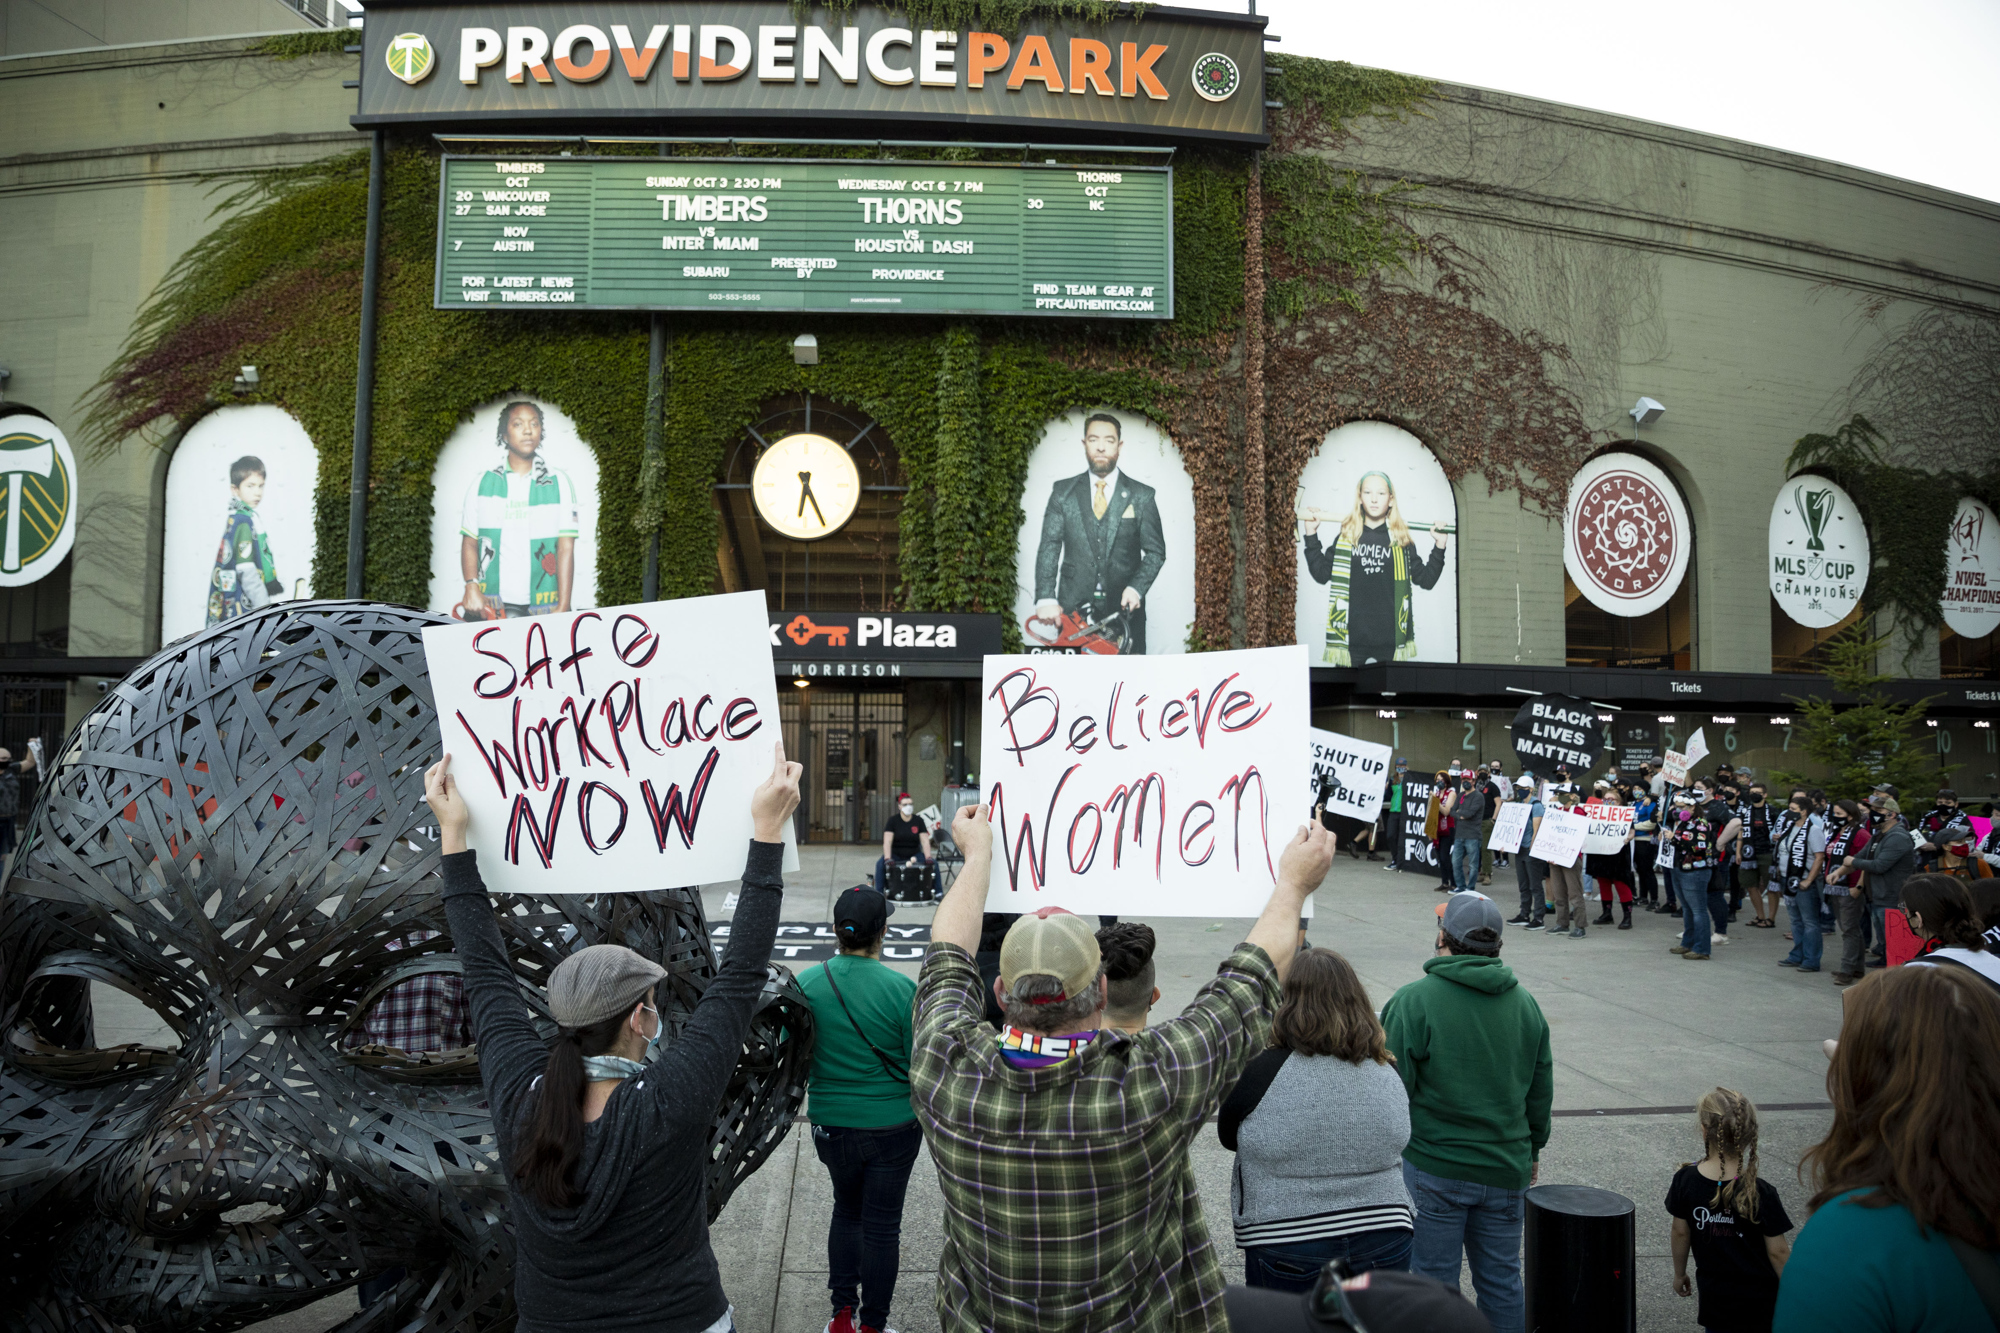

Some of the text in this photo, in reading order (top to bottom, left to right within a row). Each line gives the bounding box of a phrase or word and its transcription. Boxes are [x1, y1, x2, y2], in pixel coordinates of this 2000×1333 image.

[1198, 56, 1234, 74] PORTLAND
[1200, 79, 1234, 94] THORNS
[496, 163, 545, 173] TIMBERS
[506, 177, 529, 188] OCT
[646, 177, 690, 188] SUNDAY
[694, 177, 717, 188] OCT
[719, 178, 728, 188] 3
[763, 178, 781, 189] PM
[1077, 172, 1122, 183] THORNS
[838, 179, 983, 192] WEDNESDAY OCT 6 7 PM
[1085, 186, 1108, 197] OCT
[456, 191, 550, 202] 20 VANCOUVER
[455, 205, 546, 216] 27 SAN JOSE
[657, 195, 768, 222] TIMBERS
[858, 198, 963, 225] THORNS
[1027, 199, 1105, 211] 30 NC
[504, 227, 528, 237] NOV
[699, 227, 715, 237] VS
[903, 230, 919, 240] VS
[454, 241, 534, 252] 7 AUSTIN
[662, 236, 759, 250] INTER MIAMI
[855, 239, 973, 255] HOUSTON DASH
[771, 257, 837, 269] PRESENTED
[683, 266, 729, 277] SUBARU
[797, 268, 814, 279] BY
[872, 269, 944, 281] PROVIDENCE
[462, 277, 574, 288] FOR LATEST NEWS
[463, 291, 575, 302] VISIT TIMBERS.COM
[1033, 284, 1154, 297] FIND TEAM GEAR AT
[1036, 298, 1154, 311] PTFCAUTHENTICS.COM
[1583, 479, 1667, 524] PORTLAND
[1351, 543, 1391, 559] WOMEN
[1361, 557, 1384, 566] BALL
[1775, 556, 1855, 580] MLS CUP
[1586, 549, 1668, 590] THORNS
[1955, 570, 1987, 587] NWSL
[536, 591, 559, 605] PTF
[1775, 582, 1855, 600] CHAMPIONS
[857, 617, 957, 647] Plaza
[791, 663, 901, 677] MORRISON
[1670, 682, 1702, 693] Tickets
[1965, 690, 1997, 700] Tickets &
[988, 667, 1273, 767] Believe
[1532, 703, 1594, 729] BLACK
[1392, 721, 1399, 750] 1
[1463, 722, 1476, 750] 2
[1531, 722, 1586, 746] LIVES
[1664, 725, 1676, 751] 5
[1724, 726, 1737, 752] 6
[1782, 727, 1793, 752] 7
[1936, 730, 1951, 754] 10
[1986, 730, 1996, 754] 11
[1516, 738, 1592, 769] MATTER
[1312, 762, 1336, 778] ND
[1361, 758, 1384, 775] UP
[1406, 782, 1430, 799] THE
[504, 745, 721, 870] NOW
[1583, 804, 1636, 822] BELIEVE
[987, 763, 1278, 892] Women
[1588, 823, 1628, 837] LAYERS
[1692, 1206, 1734, 1230] Portland
